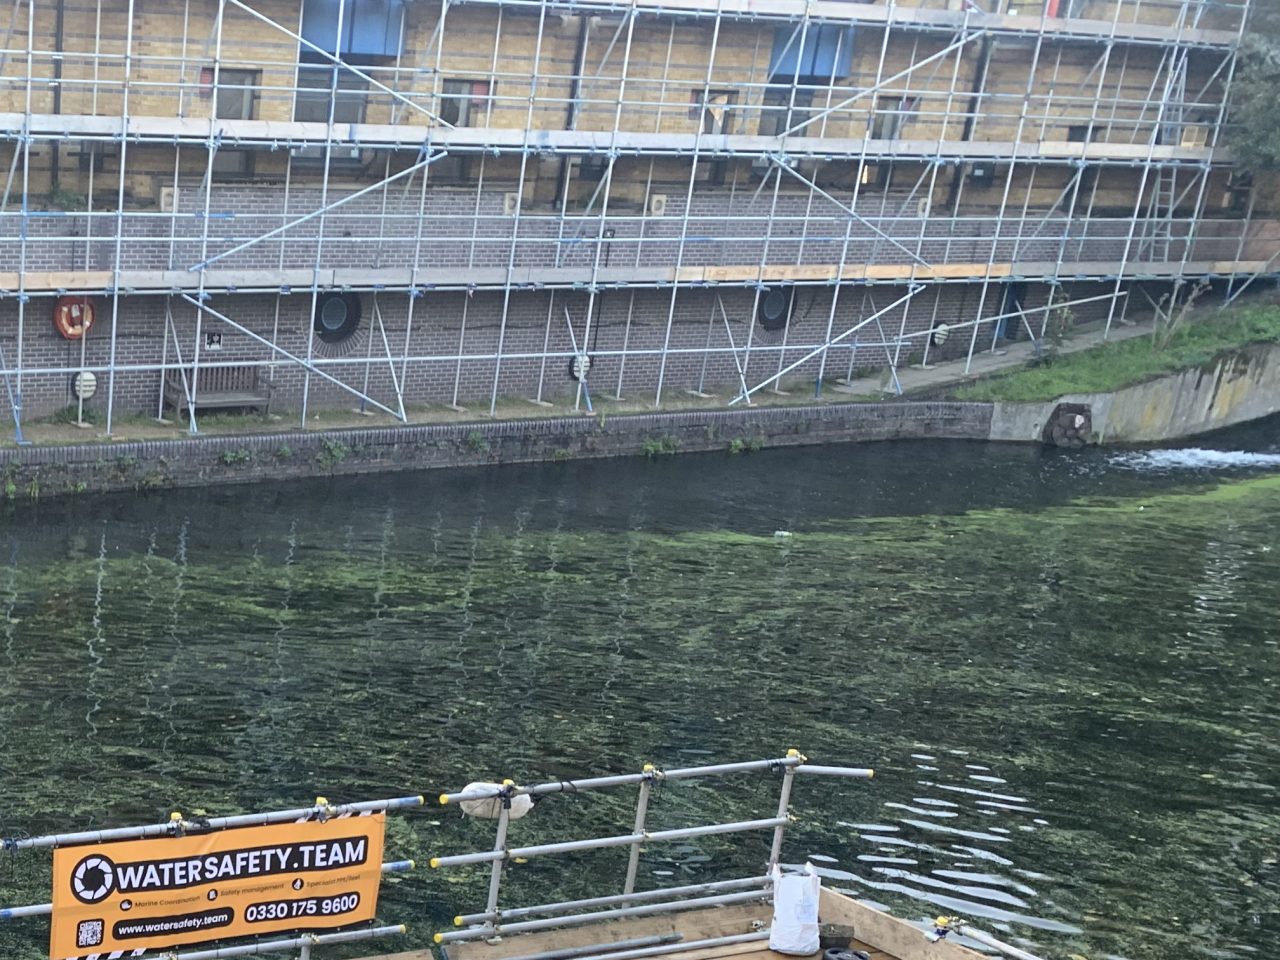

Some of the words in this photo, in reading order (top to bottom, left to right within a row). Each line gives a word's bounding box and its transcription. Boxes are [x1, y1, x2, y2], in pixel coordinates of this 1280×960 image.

[220, 888, 240, 897] Safety
[246, 903, 288, 921] 0330
[291, 900, 317, 916] 175
[321, 894, 358, 914] 9600
[118, 913, 228, 935] www.watersafety.team
